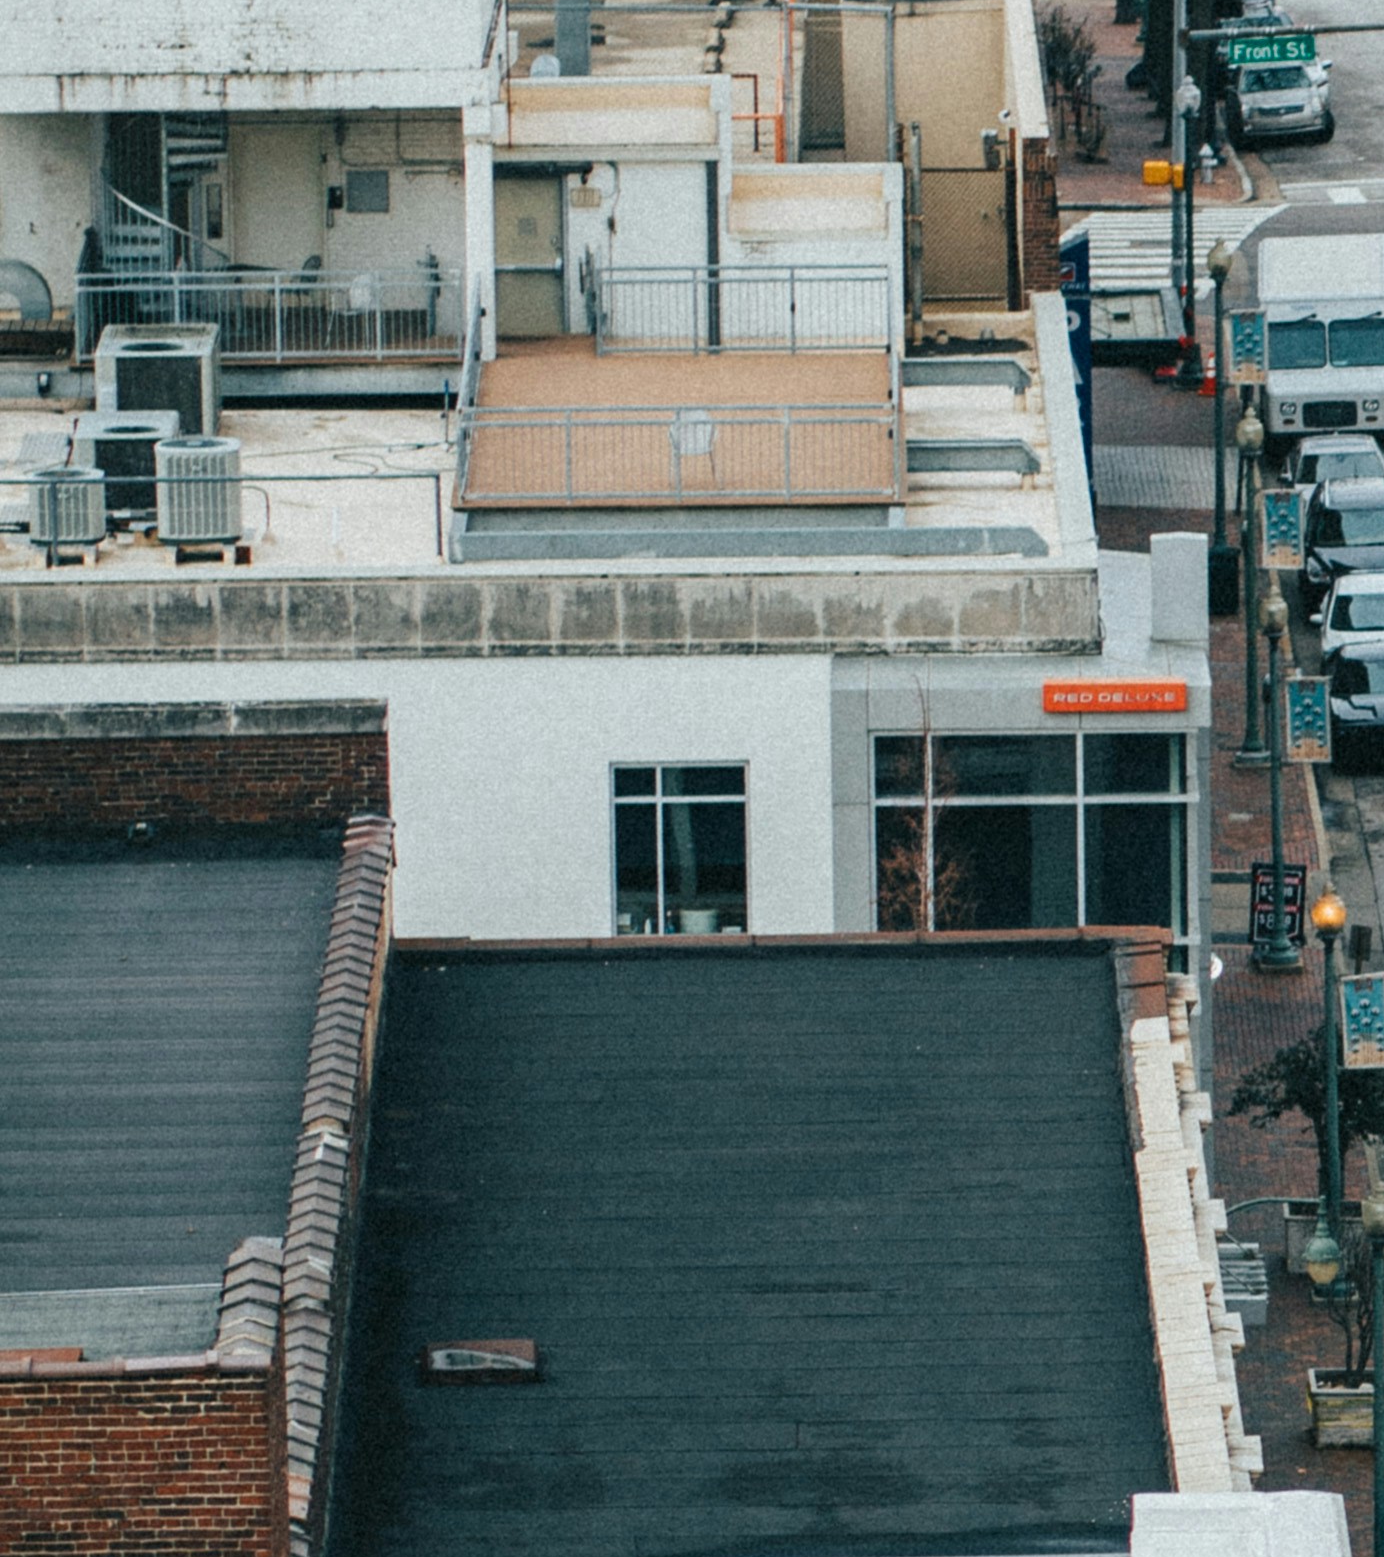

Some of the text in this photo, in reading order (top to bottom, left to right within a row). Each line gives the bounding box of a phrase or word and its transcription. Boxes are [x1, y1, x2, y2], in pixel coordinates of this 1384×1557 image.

[1233, 41, 1312, 60] Front St.
[1053, 692, 1176, 703] RED DELUXE
